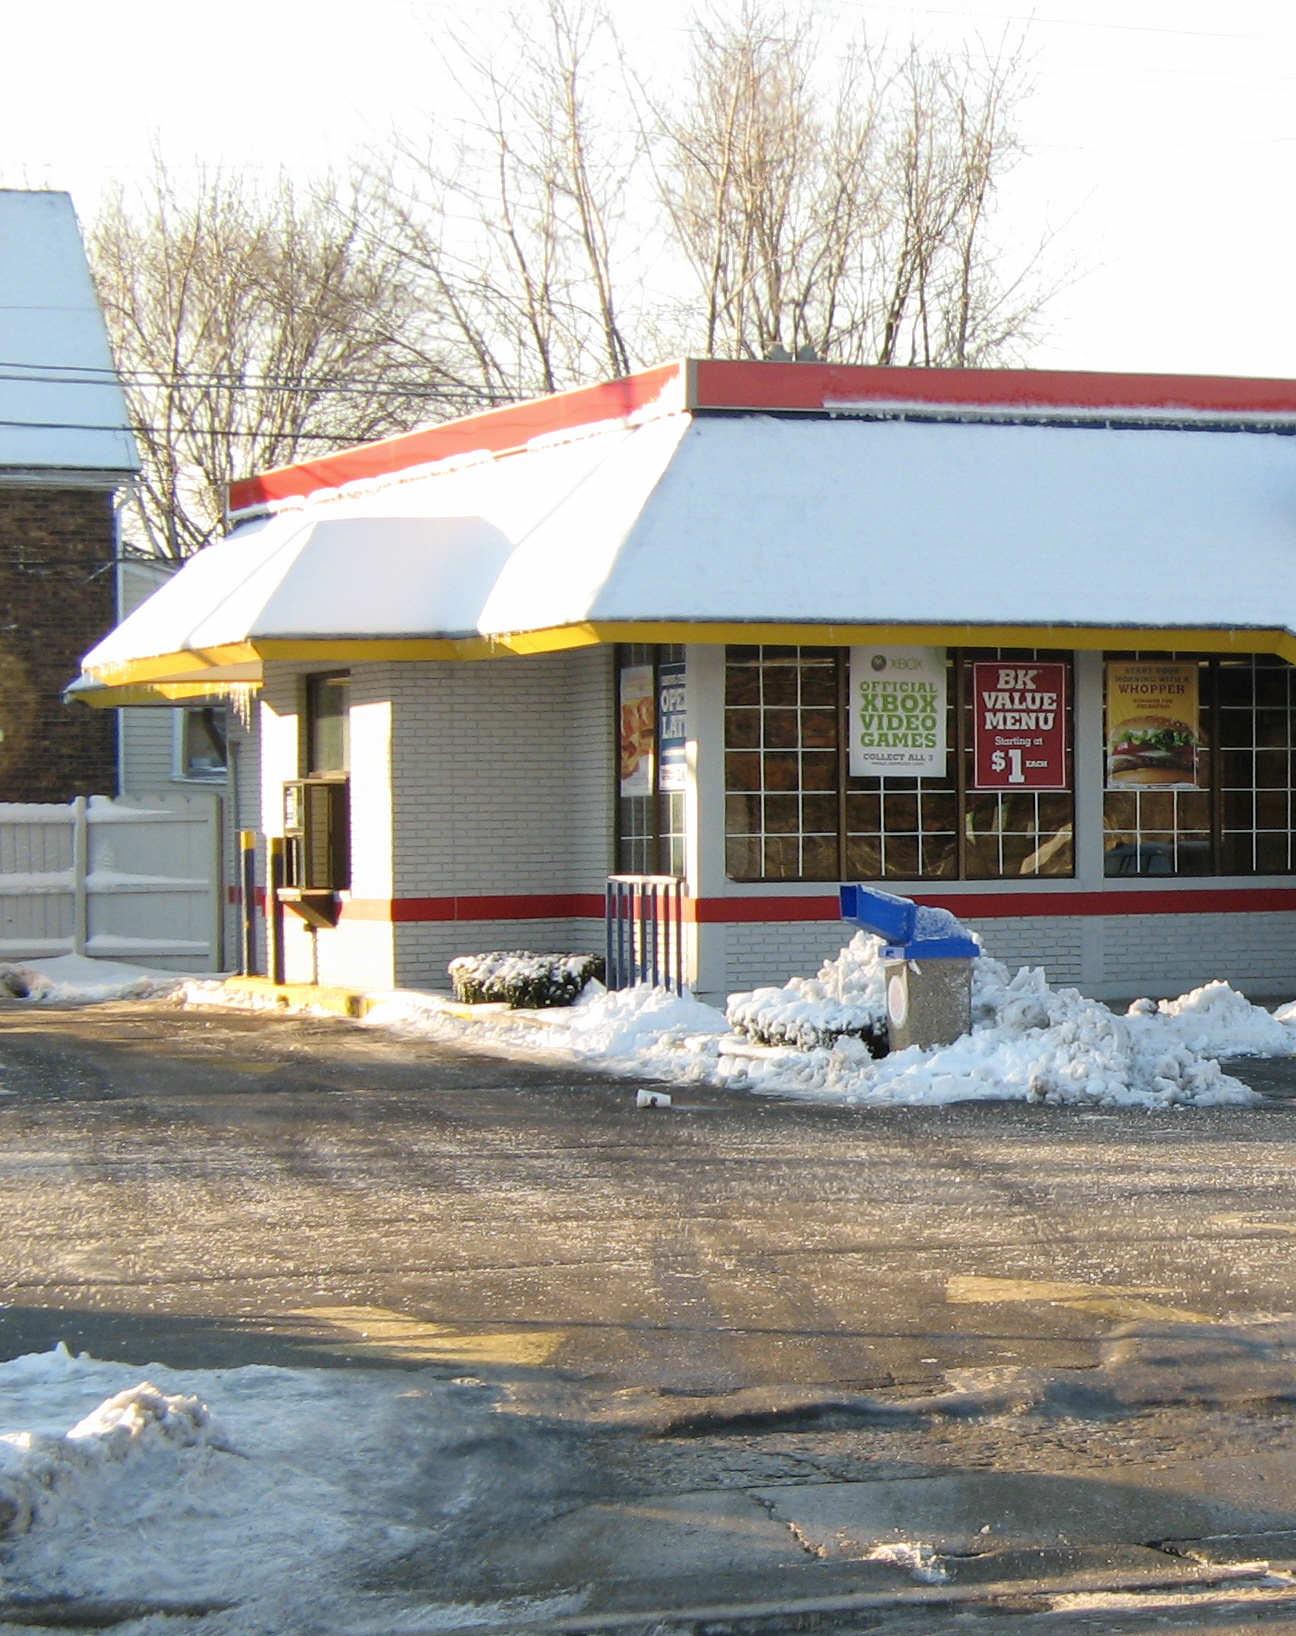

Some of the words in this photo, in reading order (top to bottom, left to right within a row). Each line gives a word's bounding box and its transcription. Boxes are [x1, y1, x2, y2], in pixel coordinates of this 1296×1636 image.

[888, 659, 922, 670] XBOX
[860, 681, 938, 693] OFFICIAL
[997, 669, 1039, 690] BK
[1118, 683, 1185, 694] WHOPPER
[860, 693, 938, 714] XBOX
[982, 692, 1058, 710] VALUE
[860, 713, 938, 732] VIDEO
[984, 712, 1056, 731] MENU
[860, 732, 938, 749] GAMES
[994, 736, 1032, 747] Starting
[1033, 737, 1044, 746] at
[863, 753, 904, 761] COLLECT
[907, 753, 926, 761] ALL
[1025, 760, 1048, 769] EACH
[991, 748, 1025, 784] $1
